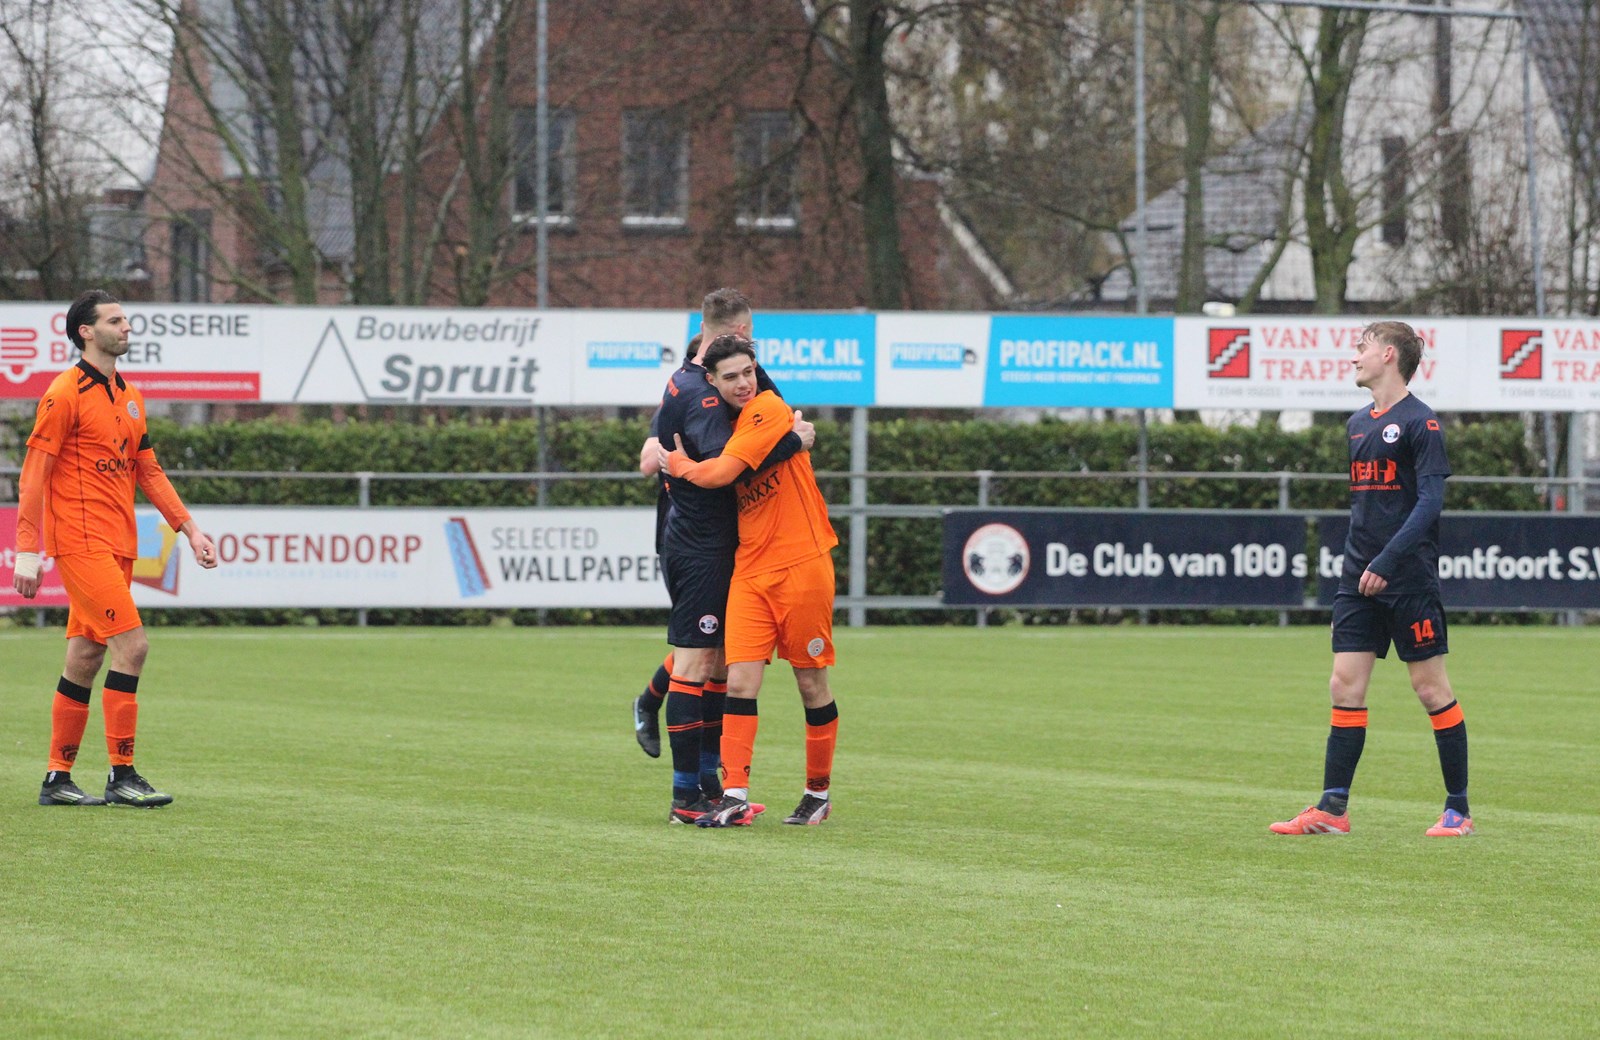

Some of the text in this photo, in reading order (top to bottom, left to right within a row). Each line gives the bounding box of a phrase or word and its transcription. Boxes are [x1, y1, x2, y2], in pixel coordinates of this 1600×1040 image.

[50, 313, 250, 336] COSSERIE
[355, 315, 541, 348] Bouwbedrijf
[1261, 327, 1437, 349] VAN VEN
[755, 338, 865, 367] IPACK.NL
[1000, 339, 1163, 369] PROFIPACK.NL
[380, 353, 540, 402] Spruit
[1260, 359, 1352, 382] TRAPP
[738, 470, 781, 513] ONXXT
[491, 527, 599, 551] SELECTED
[1046, 543, 1088, 577] De
[1093, 542, 1164, 577] Club
[1169, 553, 1226, 577] van
[1231, 543, 1287, 578] 100
[1438, 545, 1565, 580] ontfoort
[1410, 618, 1435, 643] 14
